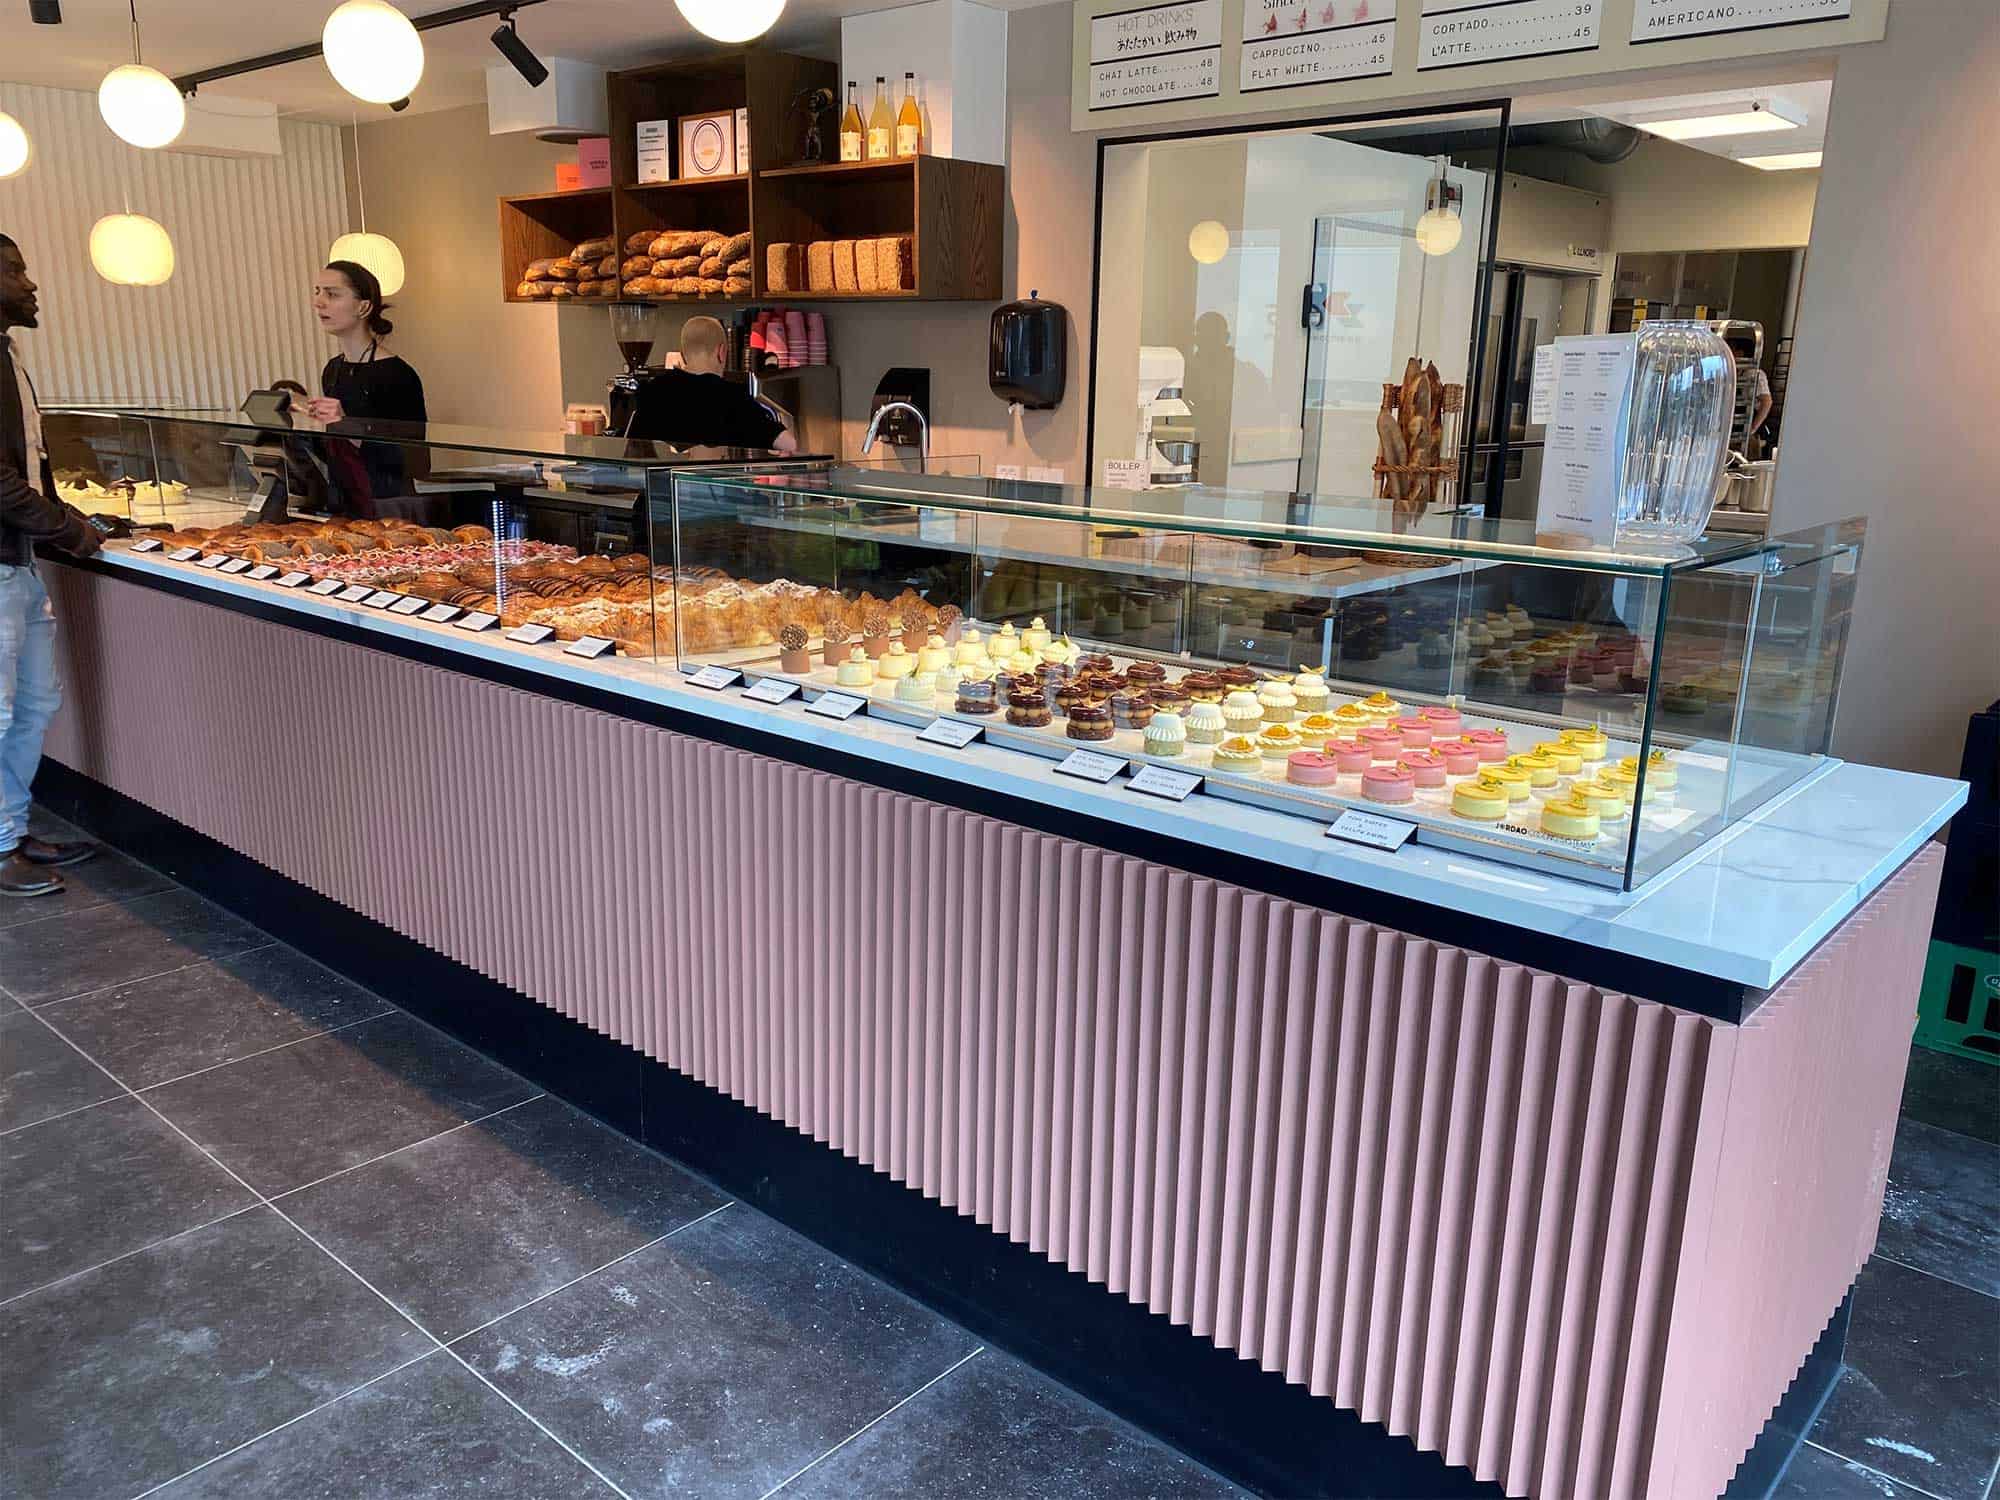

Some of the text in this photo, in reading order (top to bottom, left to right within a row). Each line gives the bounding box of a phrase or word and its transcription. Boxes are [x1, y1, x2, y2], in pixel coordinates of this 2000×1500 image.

[1117, 8, 1194, 32] HOT DRINKS
[1432, 4, 1592, 35] CORTADO 39
[1648, 6, 1735, 27] AMERICANO
[1573, 26, 1592, 38] 45
[1252, 33, 1386, 60] CAPPUCCINO 45
[1099, 70, 1122, 81] CHAI
[1128, 66, 1158, 78] LATTE
[1251, 54, 1385, 80] FLAT WHITE 45
[1099, 89, 1116, 99] HOT
[1122, 81, 1176, 96] CHOCOLATE
[1108, 462, 1141, 470] BOLLER
